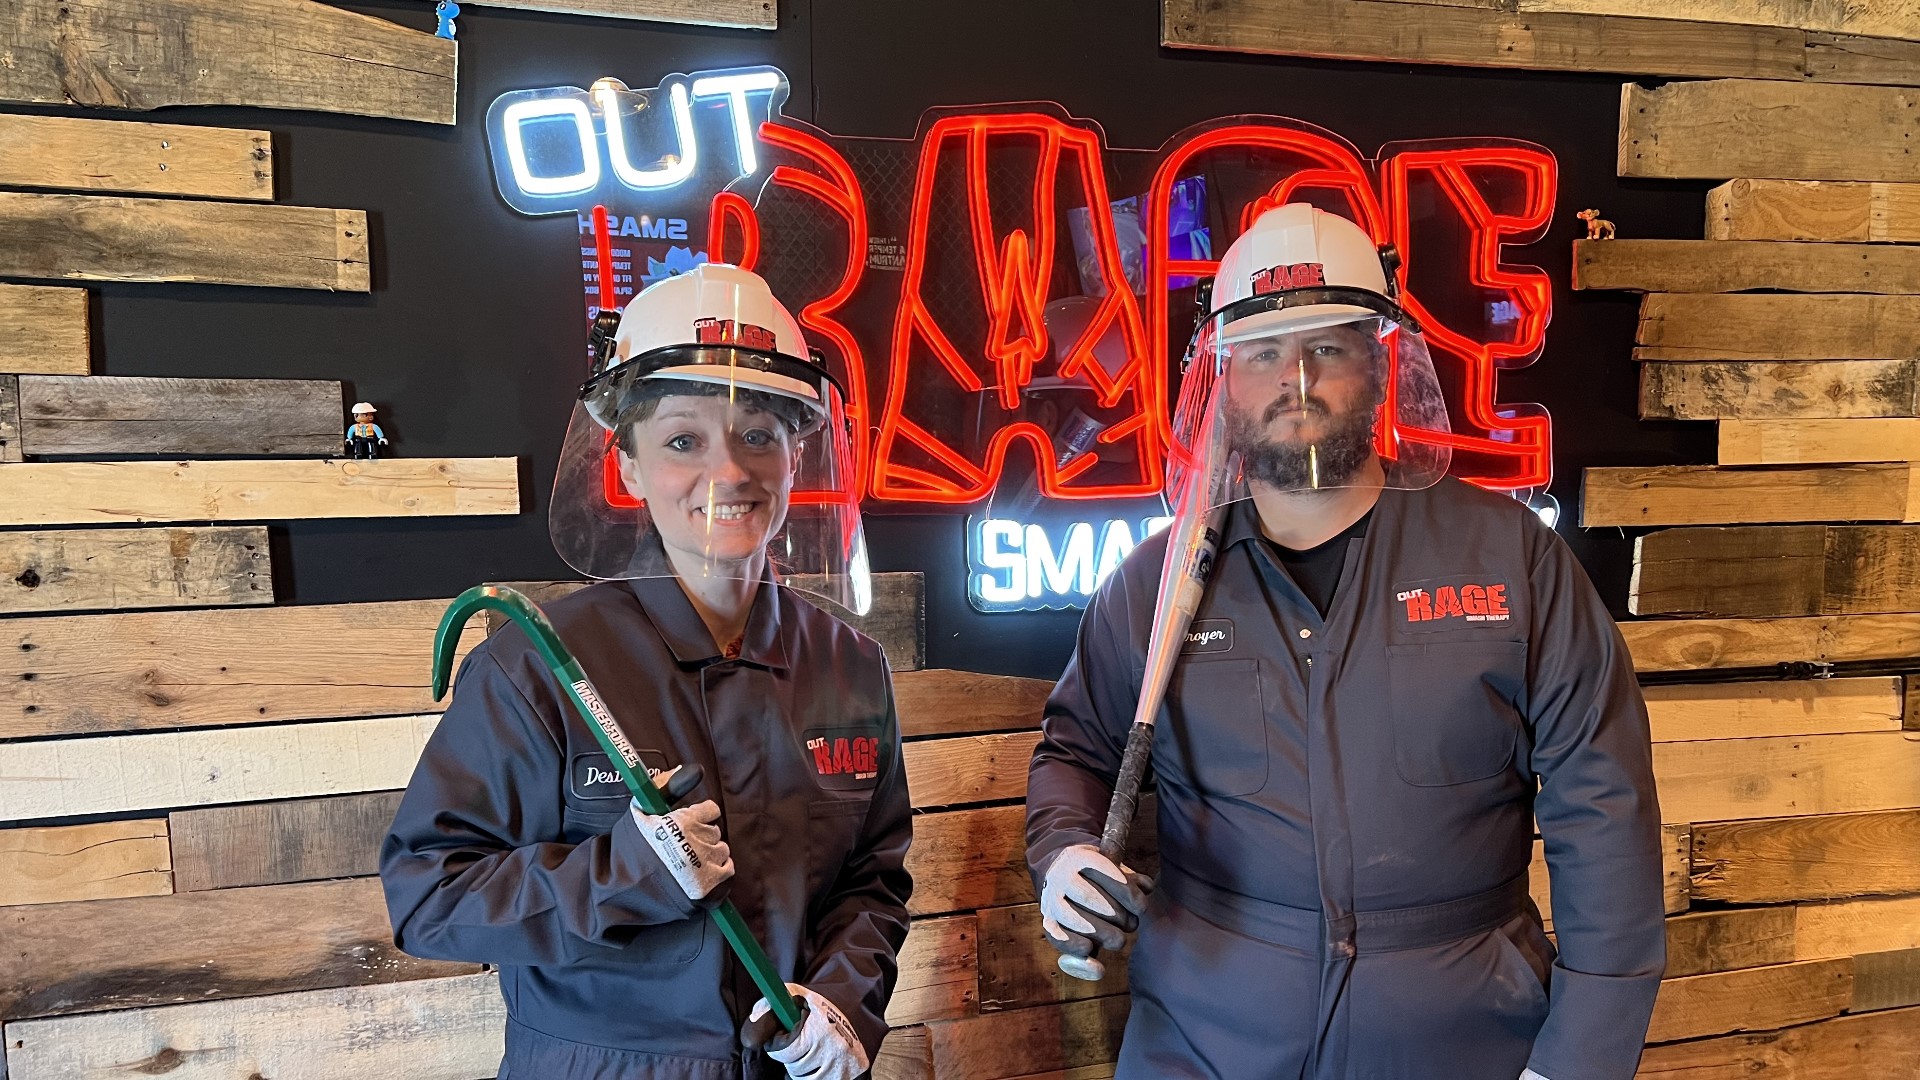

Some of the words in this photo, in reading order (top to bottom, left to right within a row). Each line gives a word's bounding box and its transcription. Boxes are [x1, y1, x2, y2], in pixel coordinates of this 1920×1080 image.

[502, 71, 781, 195] OUT
[1250, 270, 1267, 282] OUT
[1255, 263, 1324, 295] RAGE
[695, 320, 716, 328] OUT
[700, 320, 776, 352] RAGE
[976, 516, 1175, 602] SMA
[1396, 588, 1422, 601] OUT
[1406, 583, 1509, 622] RAGE
[572, 680, 638, 768] MASTERFORCE
[806, 737, 824, 750] OUT
[813, 737, 879, 775] RAGE
[662, 815, 684, 844] FIRM
[682, 840, 702, 869] GRIP
